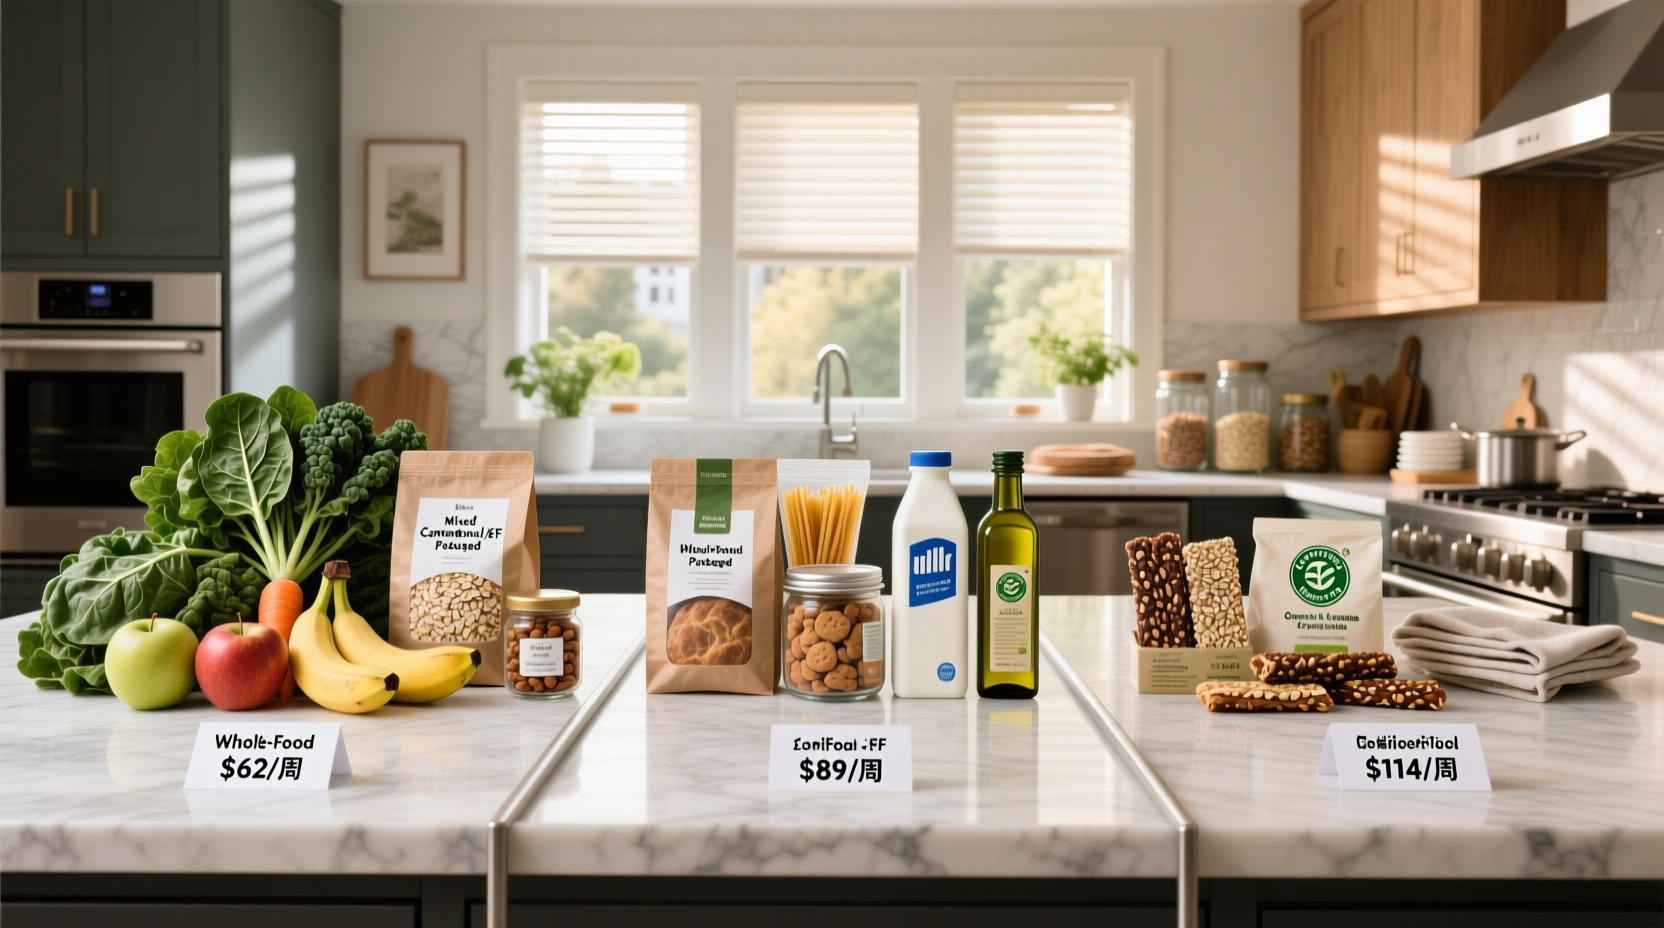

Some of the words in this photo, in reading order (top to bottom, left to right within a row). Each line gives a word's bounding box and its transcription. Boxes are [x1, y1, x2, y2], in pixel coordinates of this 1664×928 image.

[215, 733, 315, 750] Whole-Food
[220, 755, 303, 782] $62/周
[799, 757, 882, 783] $89/周
[1365, 755, 1458, 783] $114/周
